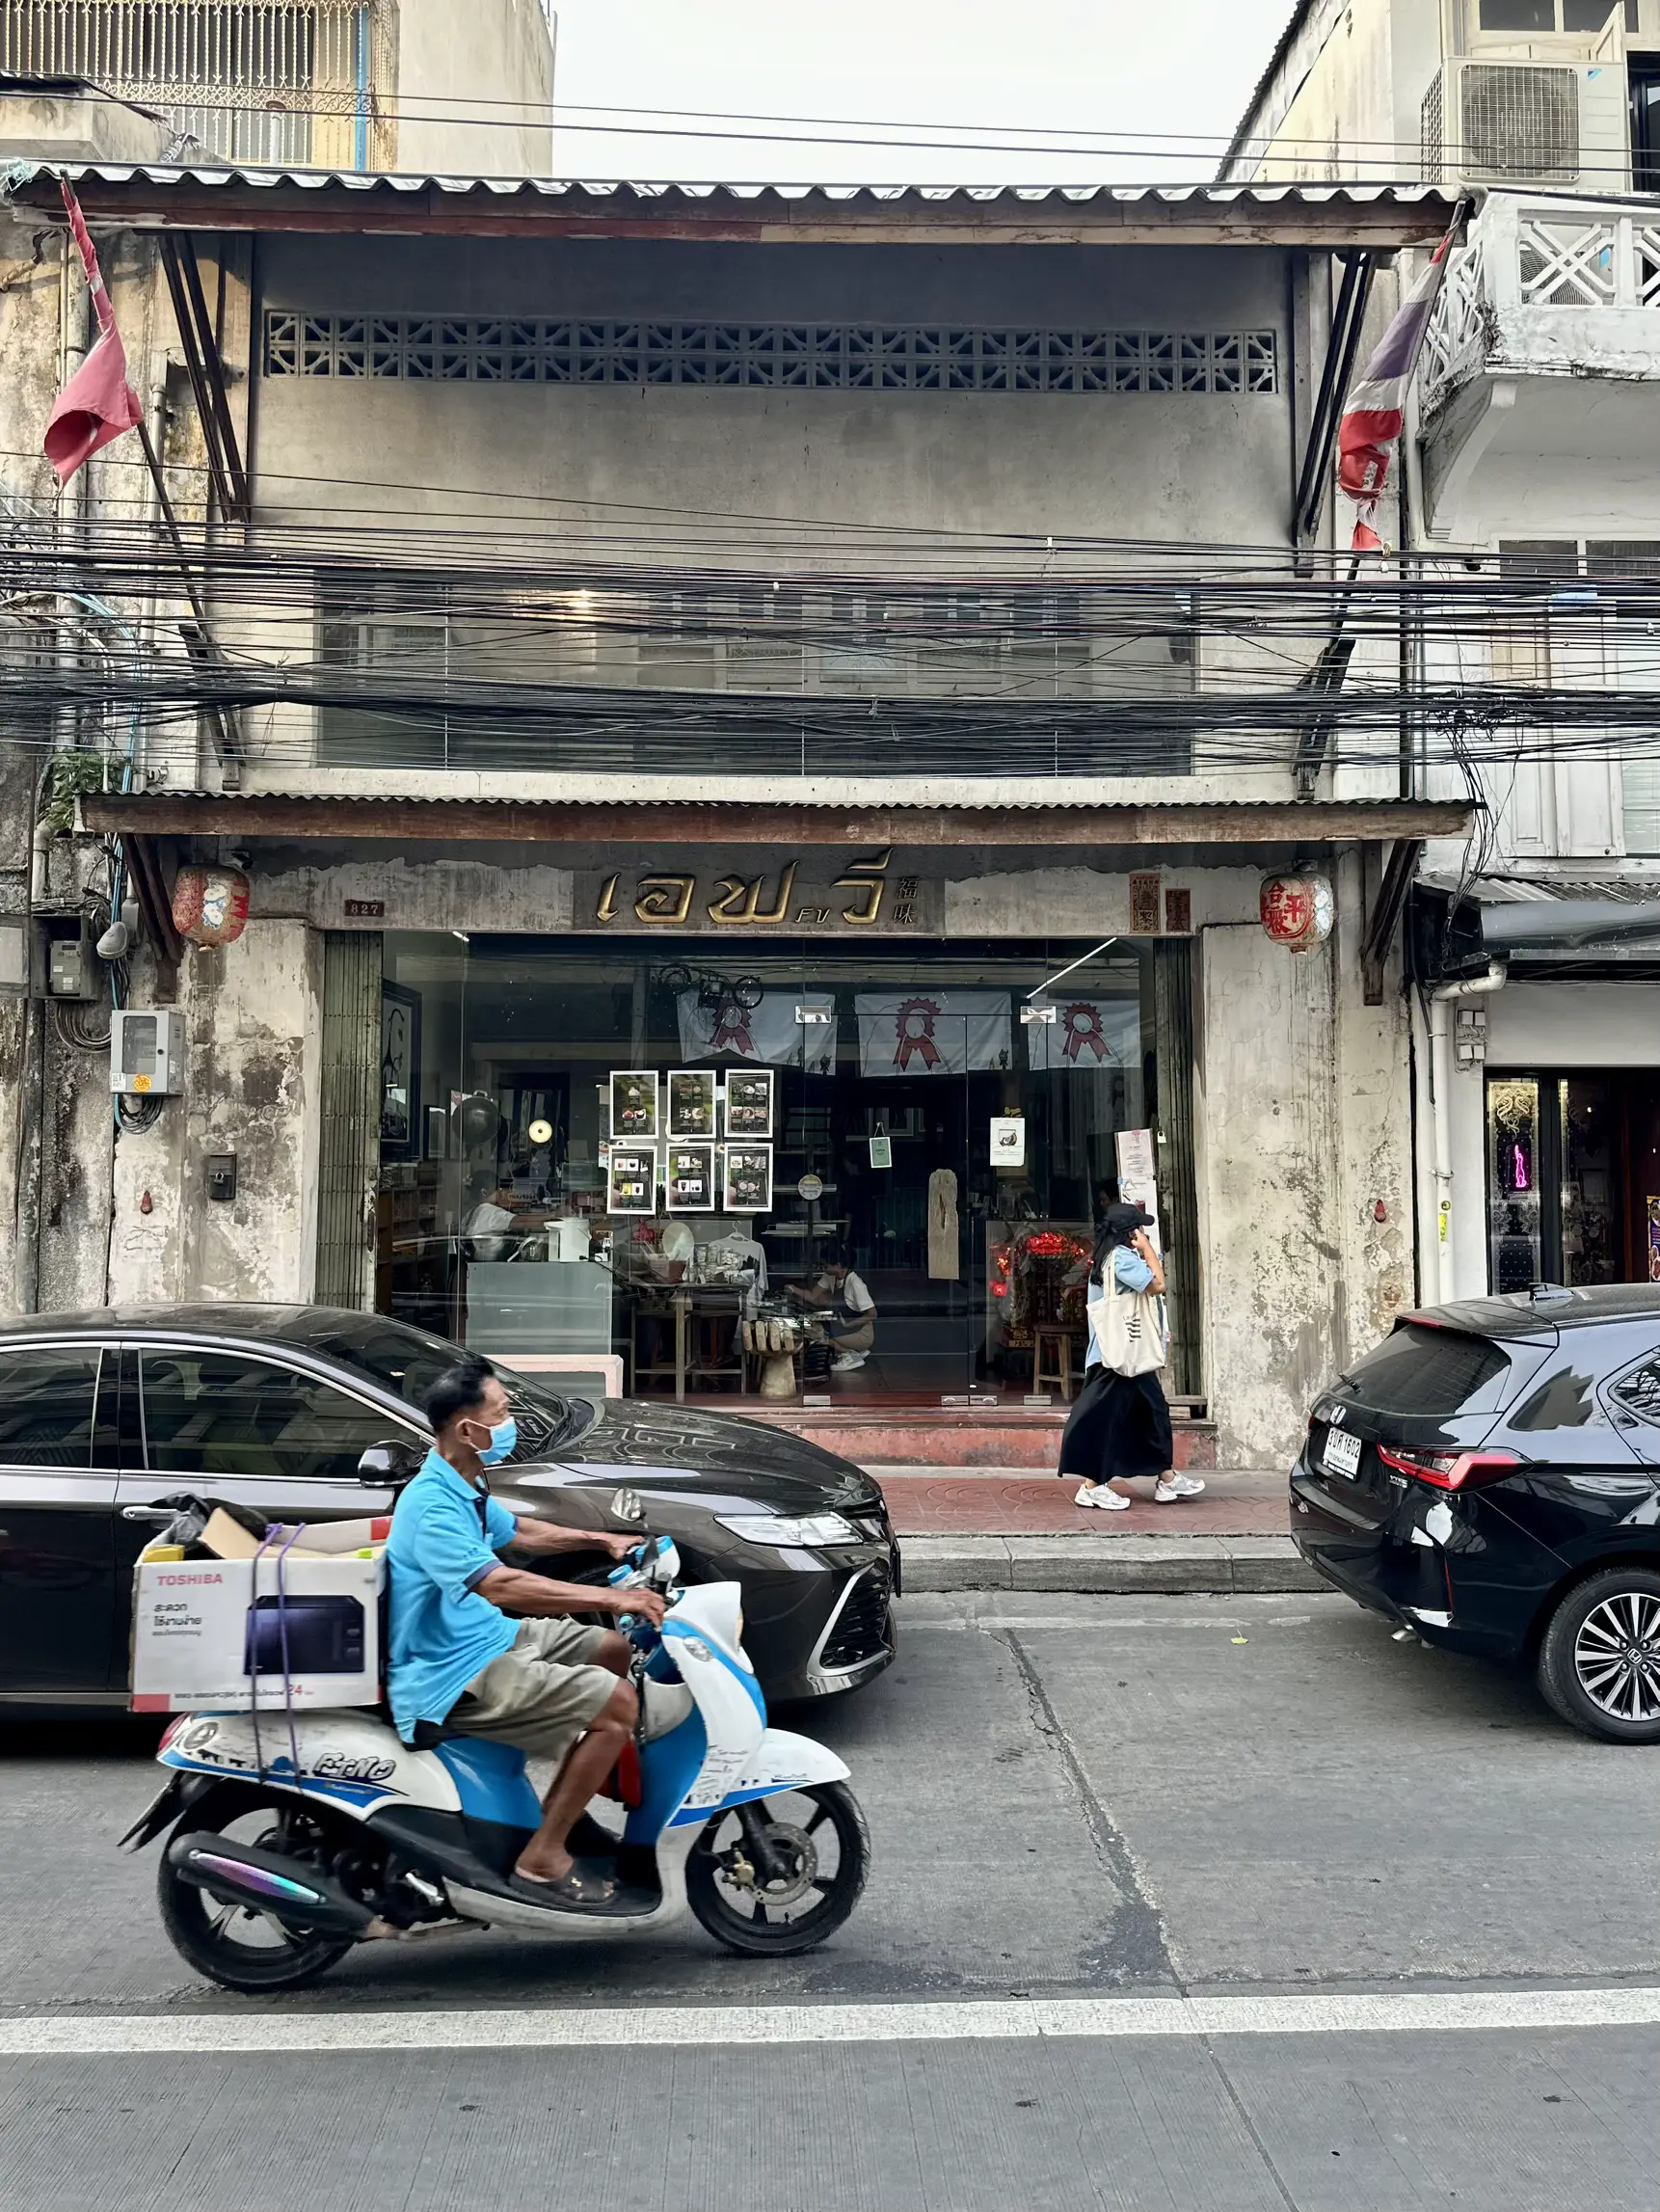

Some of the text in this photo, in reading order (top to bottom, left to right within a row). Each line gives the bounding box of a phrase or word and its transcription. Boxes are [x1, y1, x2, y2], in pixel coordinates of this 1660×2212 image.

[351, 904, 380, 915] 827
[1343, 1436, 1360, 1459] 1602
[155, 1573, 224, 1586] TOSHIBA
